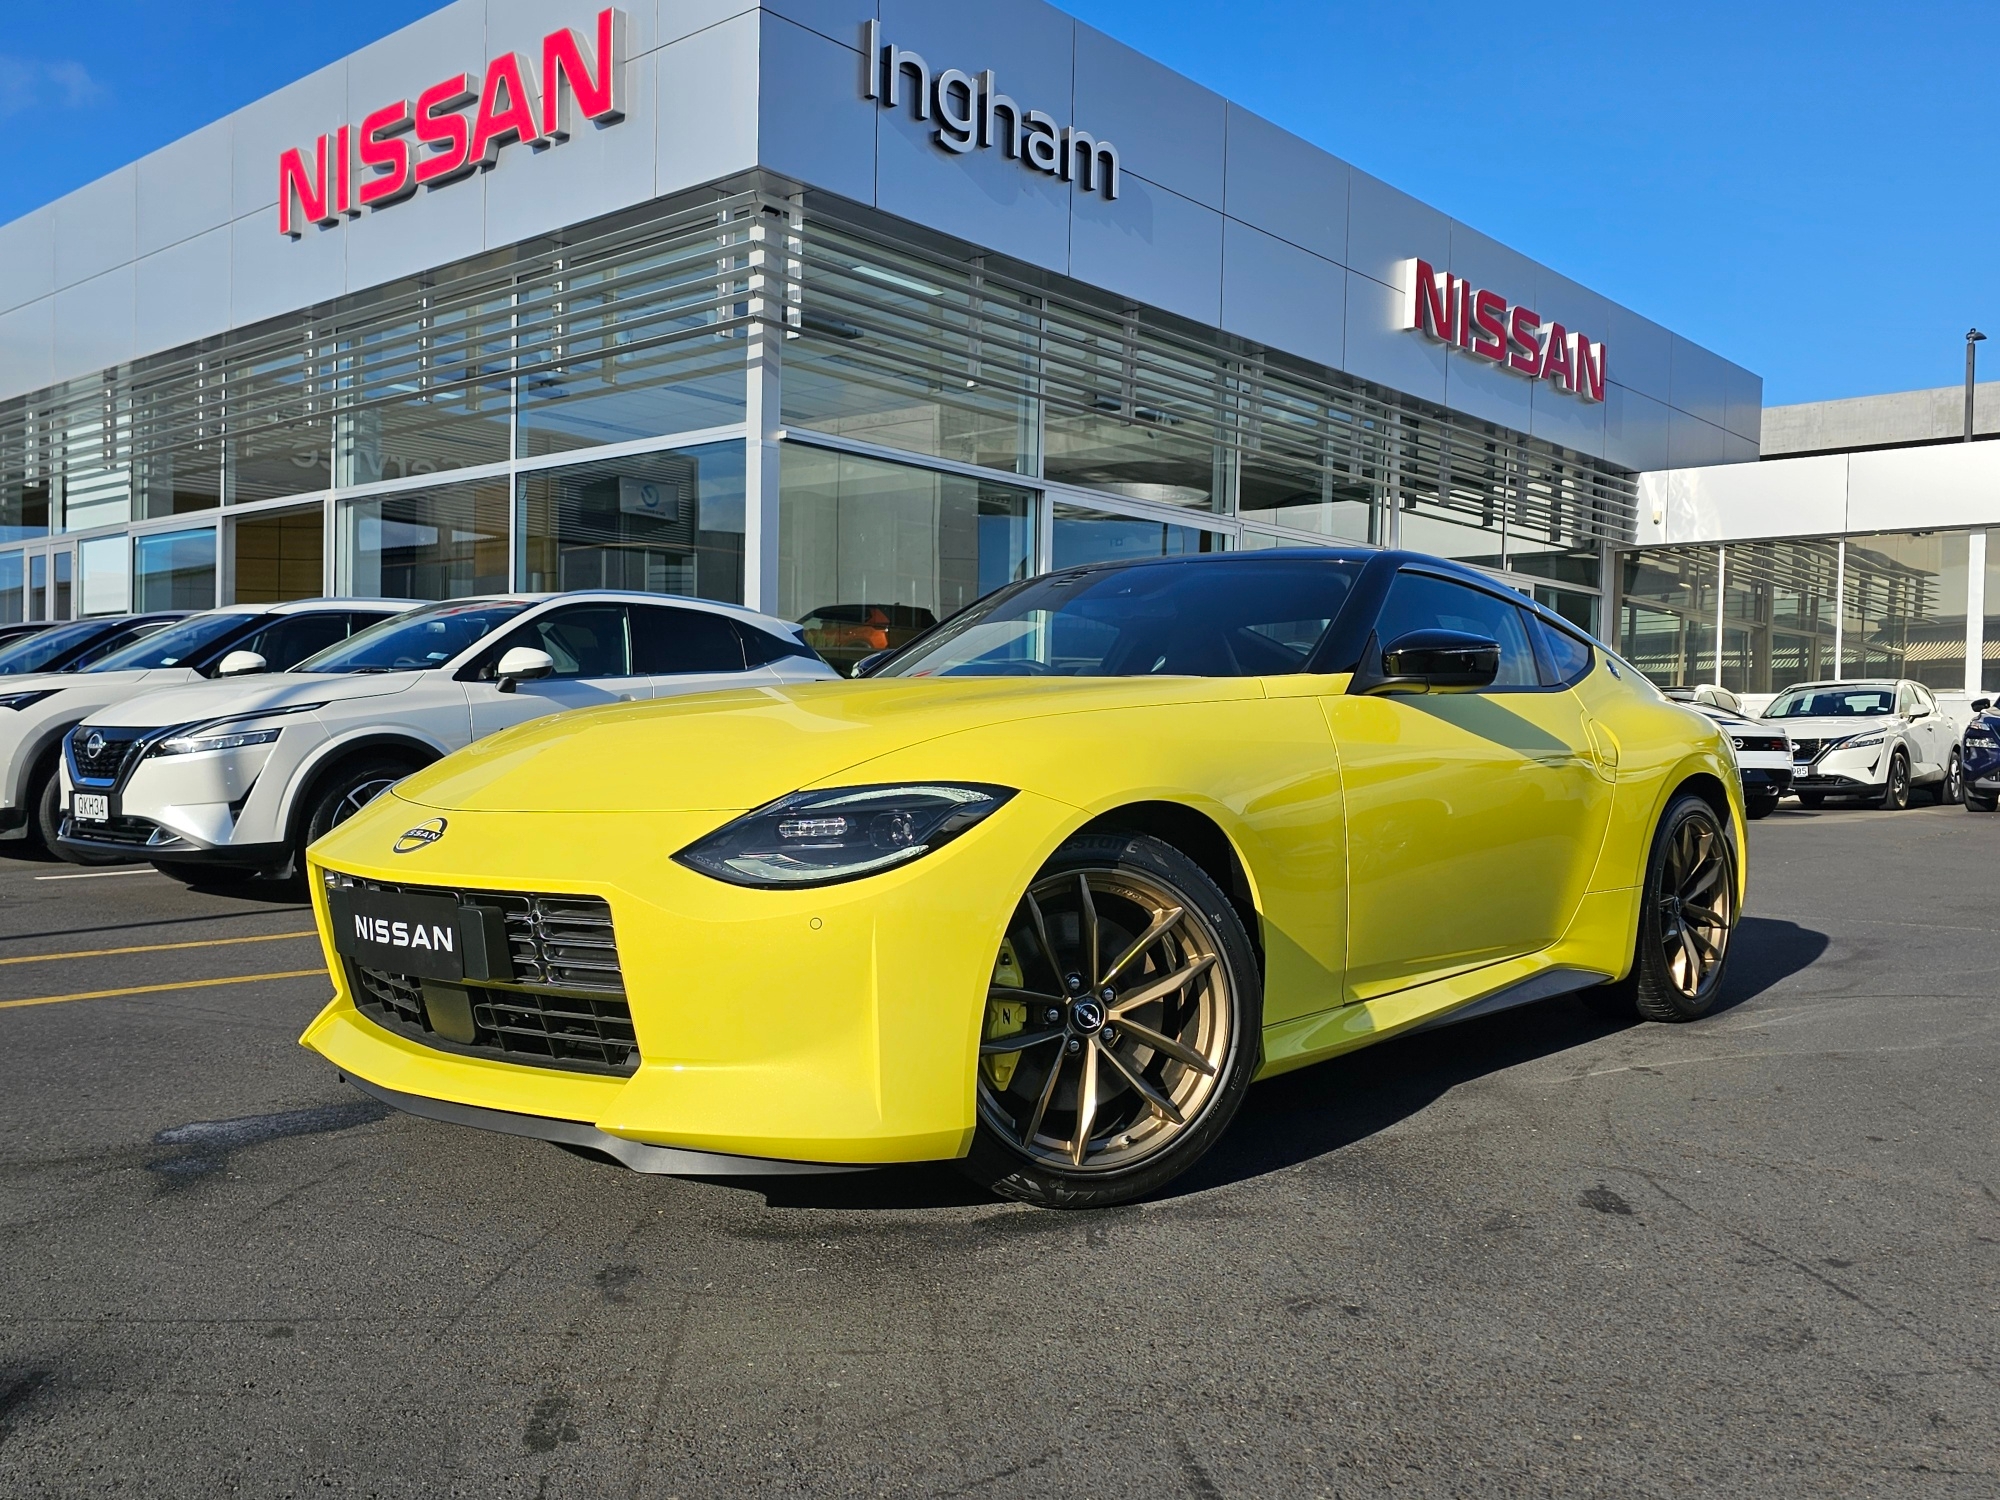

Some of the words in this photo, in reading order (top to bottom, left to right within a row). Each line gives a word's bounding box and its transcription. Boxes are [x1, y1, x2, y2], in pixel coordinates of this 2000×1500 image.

[279, 7, 620, 236] NISSAN
[867, 19, 1120, 199] Ingham
[1411, 258, 1606, 402] NISSAN
[78, 796, 105, 816] QKH34
[404, 829, 441, 840] SSAN
[354, 914, 453, 952] NISSAN
